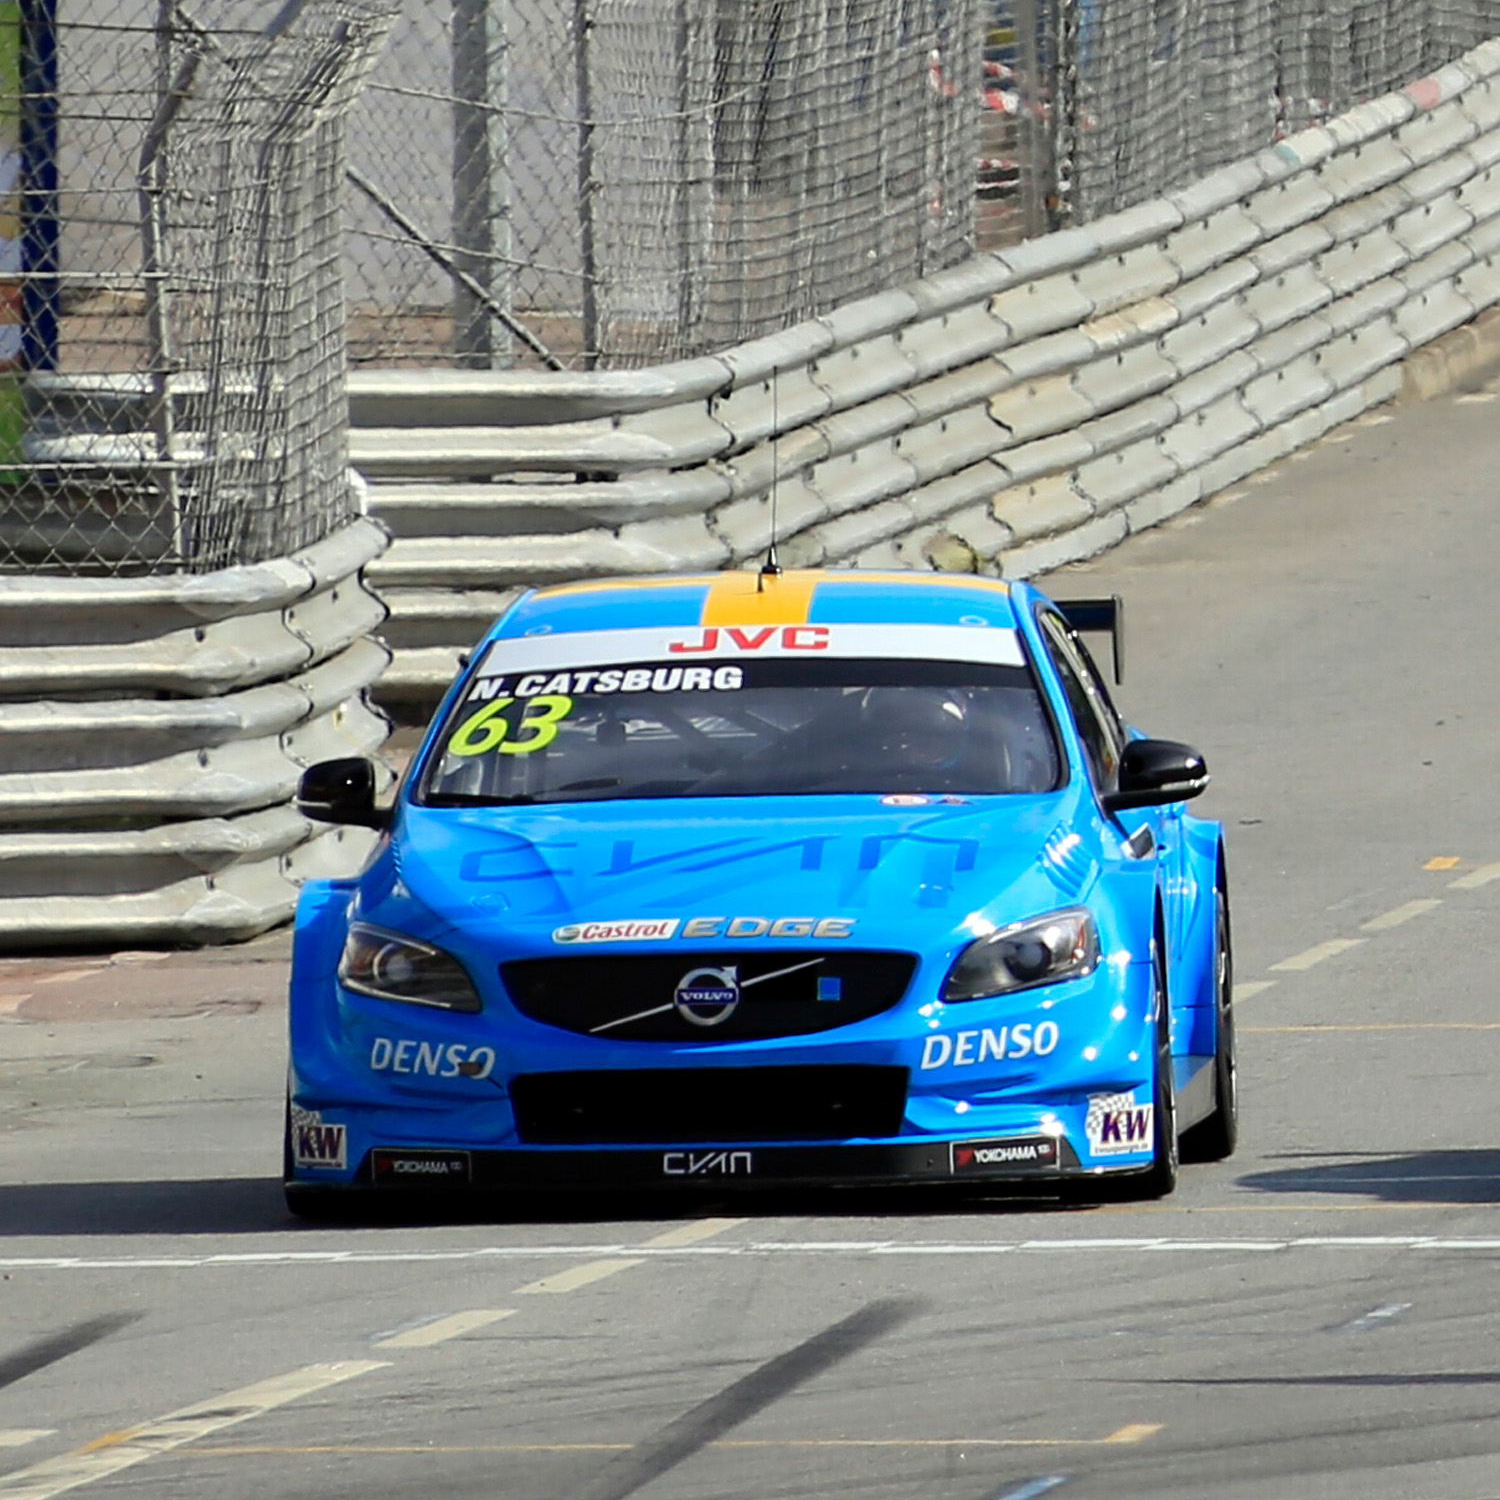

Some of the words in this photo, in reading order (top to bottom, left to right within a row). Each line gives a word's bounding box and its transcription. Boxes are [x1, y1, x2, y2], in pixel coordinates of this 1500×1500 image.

[668, 626, 830, 653] JVC
[447, 695, 573, 757] 63
[582, 920, 669, 940] Castrol
[681, 916, 859, 939] EDGE
[680, 990, 734, 1001] VOLVO
[370, 1037, 496, 1080] DENSO
[920, 1020, 1060, 1070] DENSO
[1101, 1107, 1151, 1145] KW
[299, 1126, 344, 1160] KW
[973, 1145, 1038, 1164] YOKOHAMA
[392, 1160, 449, 1174] YOKOHAMA
